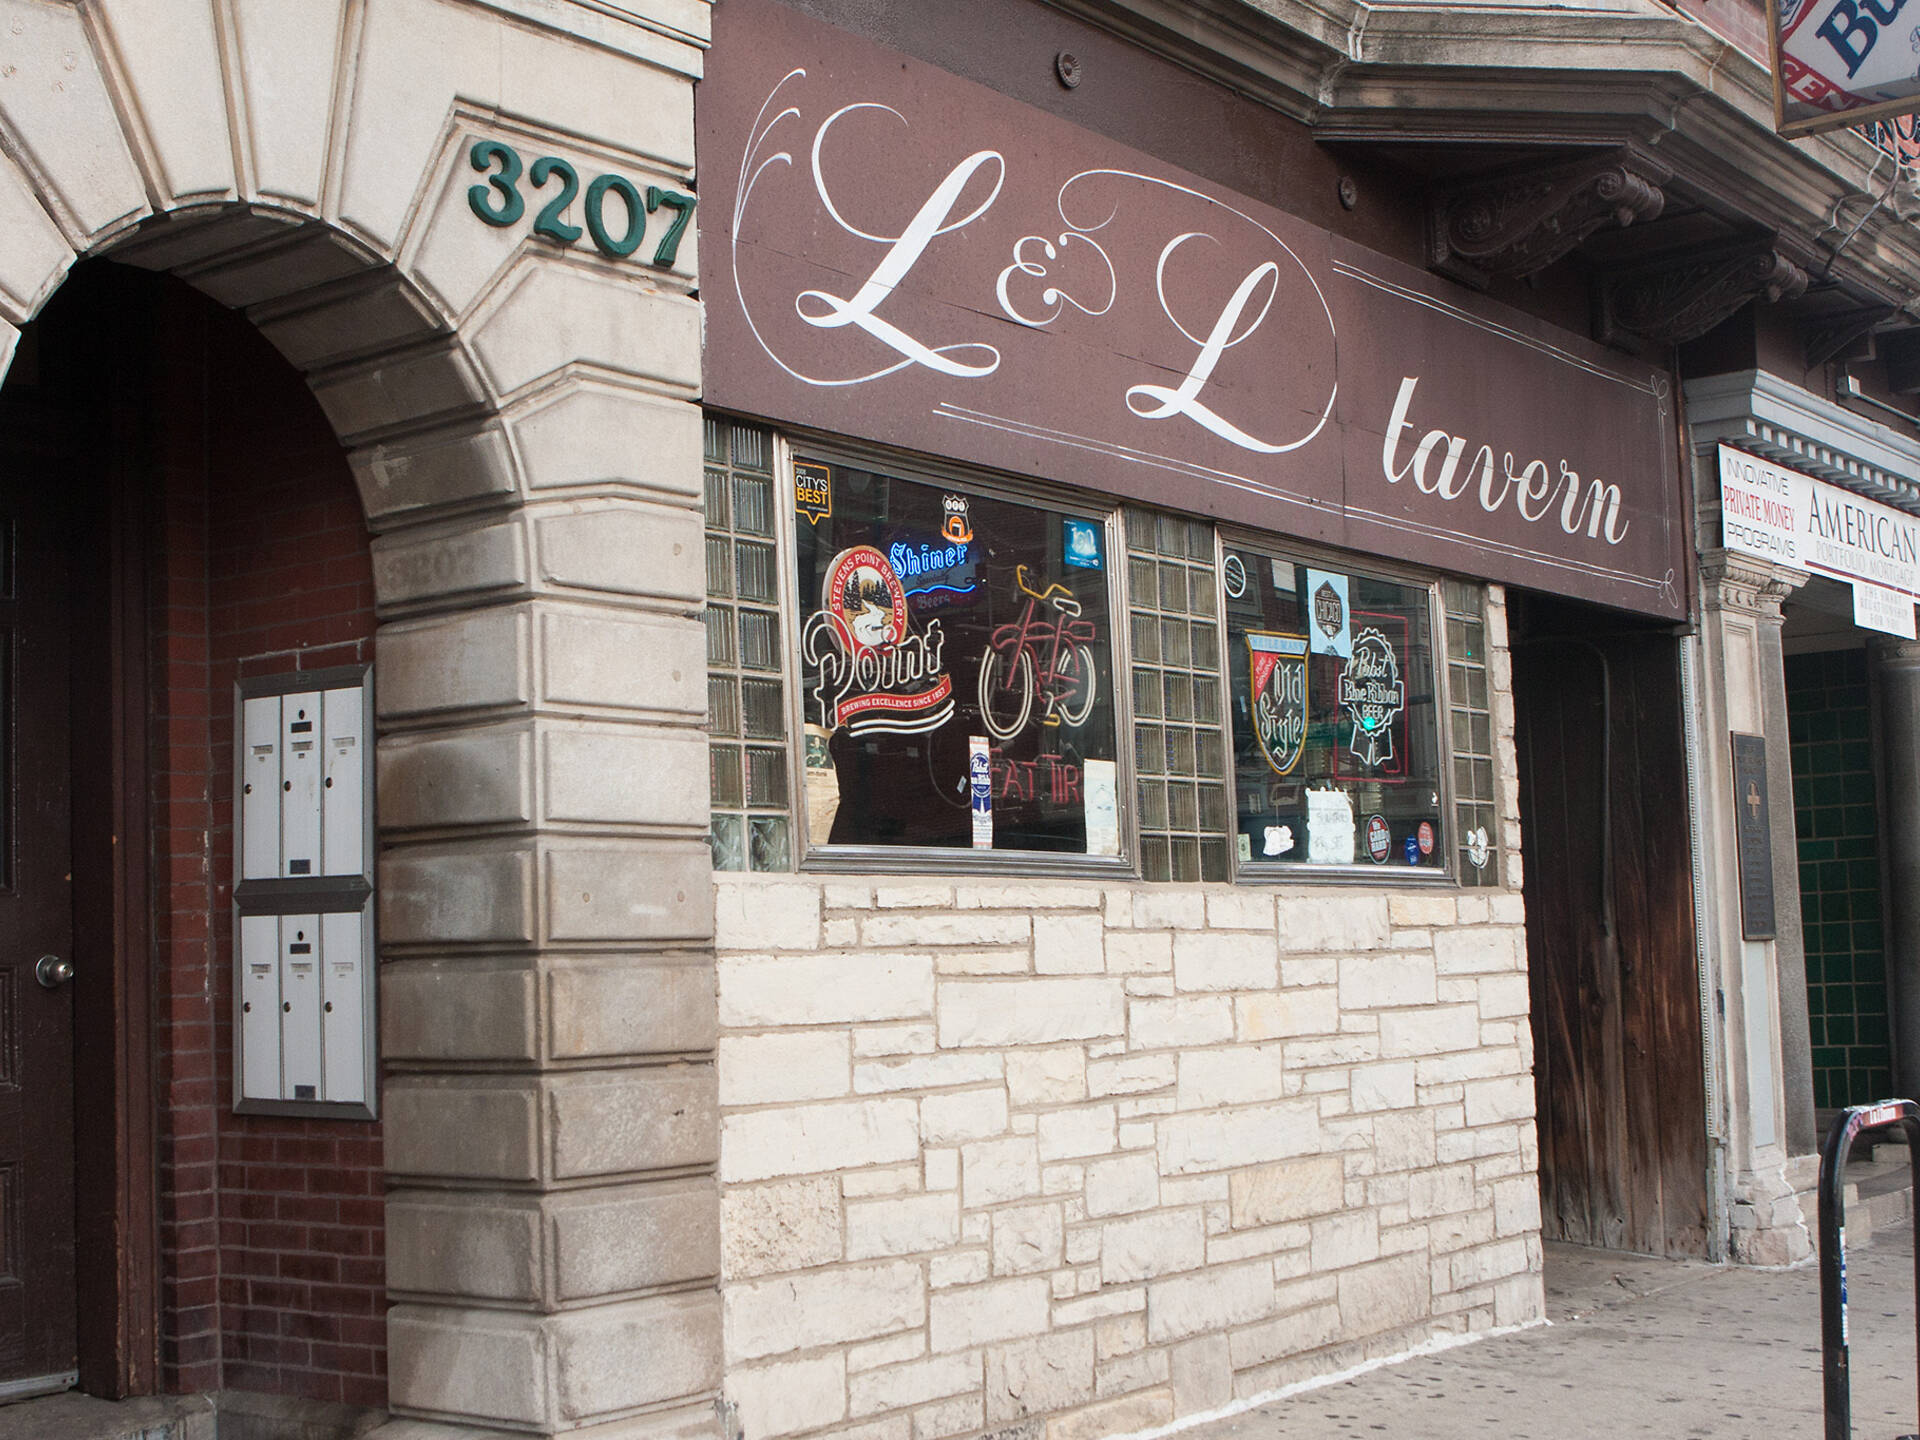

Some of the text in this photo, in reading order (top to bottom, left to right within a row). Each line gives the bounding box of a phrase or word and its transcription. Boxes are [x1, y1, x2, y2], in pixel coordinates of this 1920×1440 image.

[468, 140, 697, 268] 3207
[796, 102, 1630, 546] L & L tavern
[797, 487, 828, 505] BEST
[1723, 485, 1795, 532] PRIVATE MONEY
[1727, 521, 1796, 559] PROGRAMS
[1808, 484, 1918, 565] AMERICAN
[889, 542, 968, 579] Shiner
[832, 552, 905, 626] STEVENS POINT BREWERY
[1316, 599, 1340, 623] CHICAGO
[803, 611, 944, 732] Point
[1273, 659, 1301, 705] Old
[1355, 646, 1390, 680] Pabst
[840, 687, 946, 715] BREWING EXCELLENCE SINCE 1857
[1343, 679, 1400, 705] Blue Ribbon
[1362, 704, 1384, 720] BEER
[1260, 691, 1301, 758] Style
[1042, 754, 1083, 804] TIR
